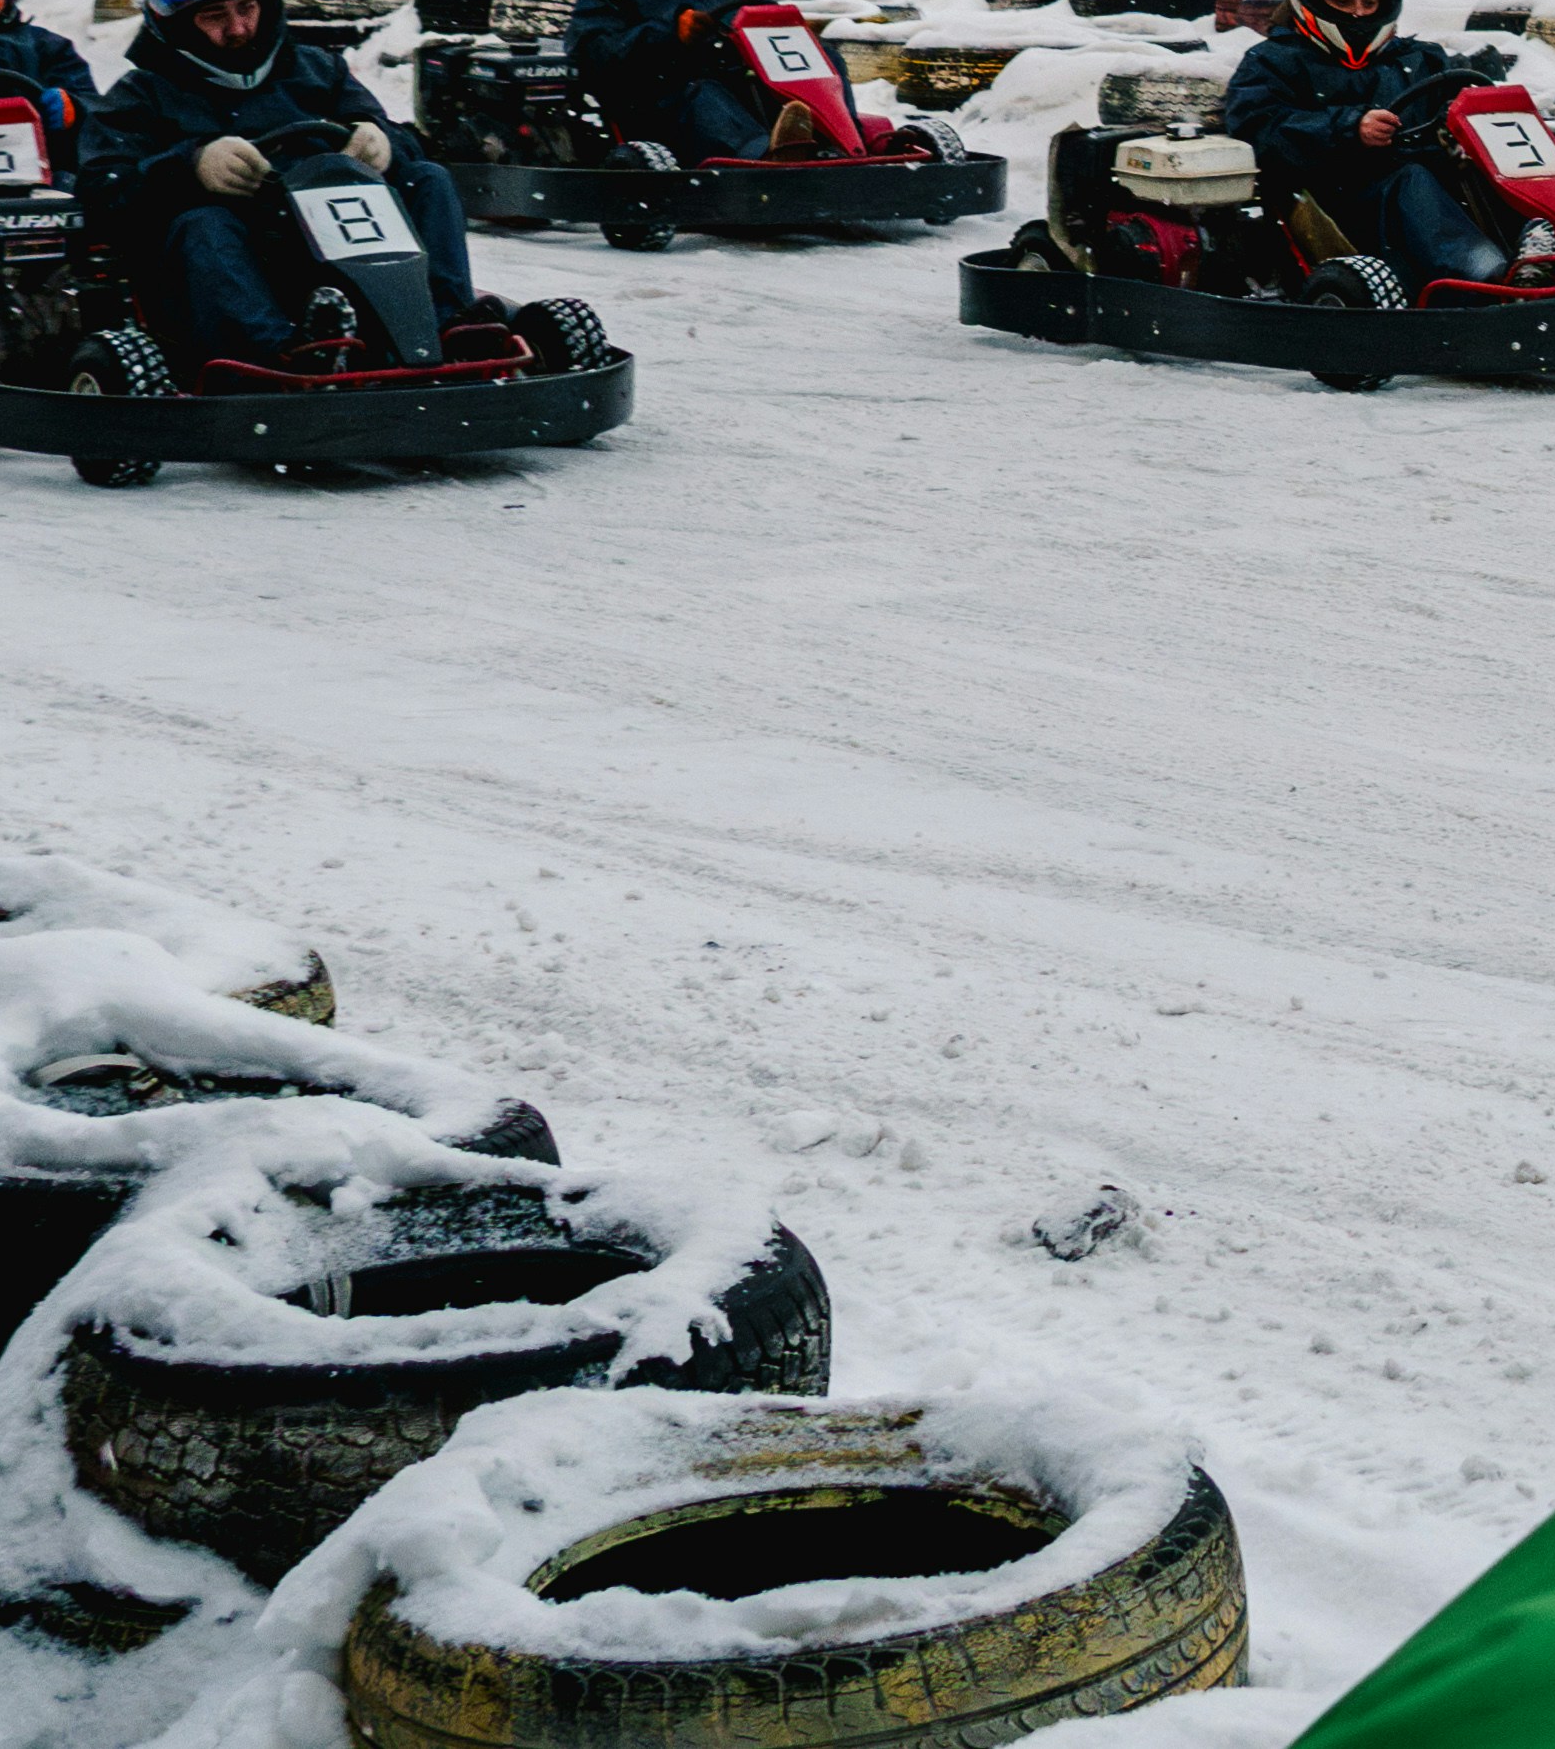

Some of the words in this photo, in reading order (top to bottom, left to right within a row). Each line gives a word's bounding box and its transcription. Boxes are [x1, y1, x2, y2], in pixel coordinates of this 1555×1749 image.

[767, 35, 812, 72] 6
[1491, 121, 1545, 168] 3
[6, 213, 67, 230] LIFAN
[325, 196, 386, 244] 8
